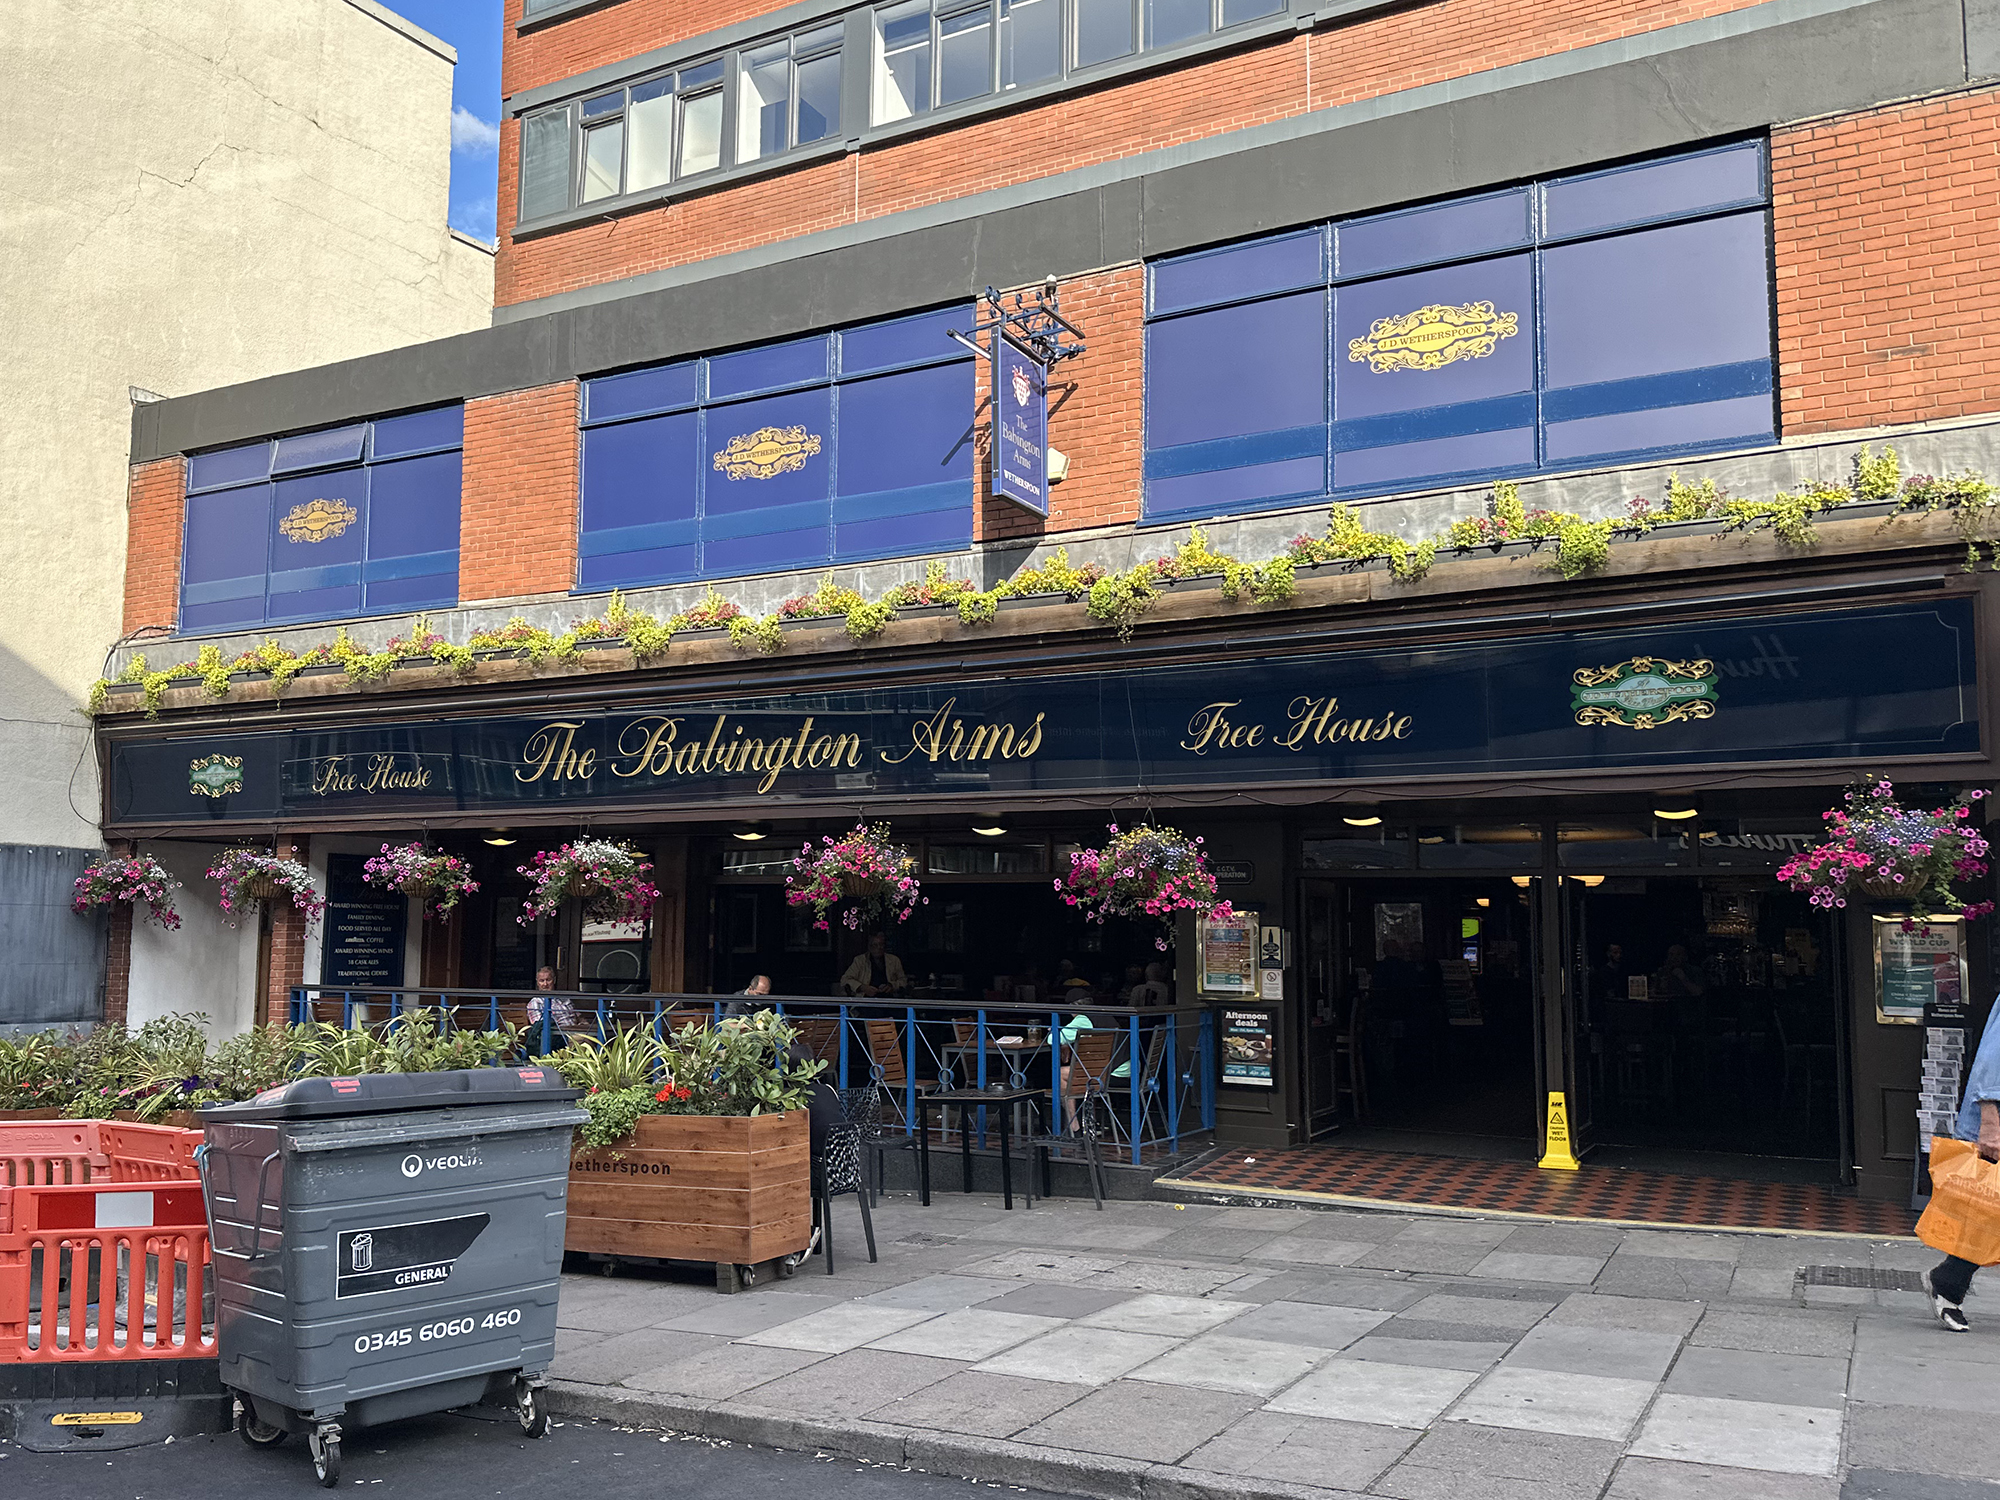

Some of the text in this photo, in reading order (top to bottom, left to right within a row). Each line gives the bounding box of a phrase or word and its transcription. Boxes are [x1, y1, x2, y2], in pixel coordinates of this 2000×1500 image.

[1399, 325, 1482, 345] WETHERSPOON
[1015, 414, 1028, 432] The
[1002, 421, 1041, 458] Babington
[746, 444, 799, 459] WETHERSPOON
[1013, 449, 1032, 469] Arms
[1003, 469, 1040, 496] WETHERSPOON
[1601, 685, 1704, 699] WETHERSPOON
[1180, 696, 1413, 755] Free House
[515, 697, 1046, 794] The Babington Arms
[312, 754, 433, 796] Free House
[1929, 939, 1950, 947] CUP
[1225, 1011, 1268, 1020] Afternoon
[1235, 1019, 1258, 1027] deals
[395, 1266, 448, 1285] GENERAL
[354, 1308, 521, 1353] 0345 6060 460
